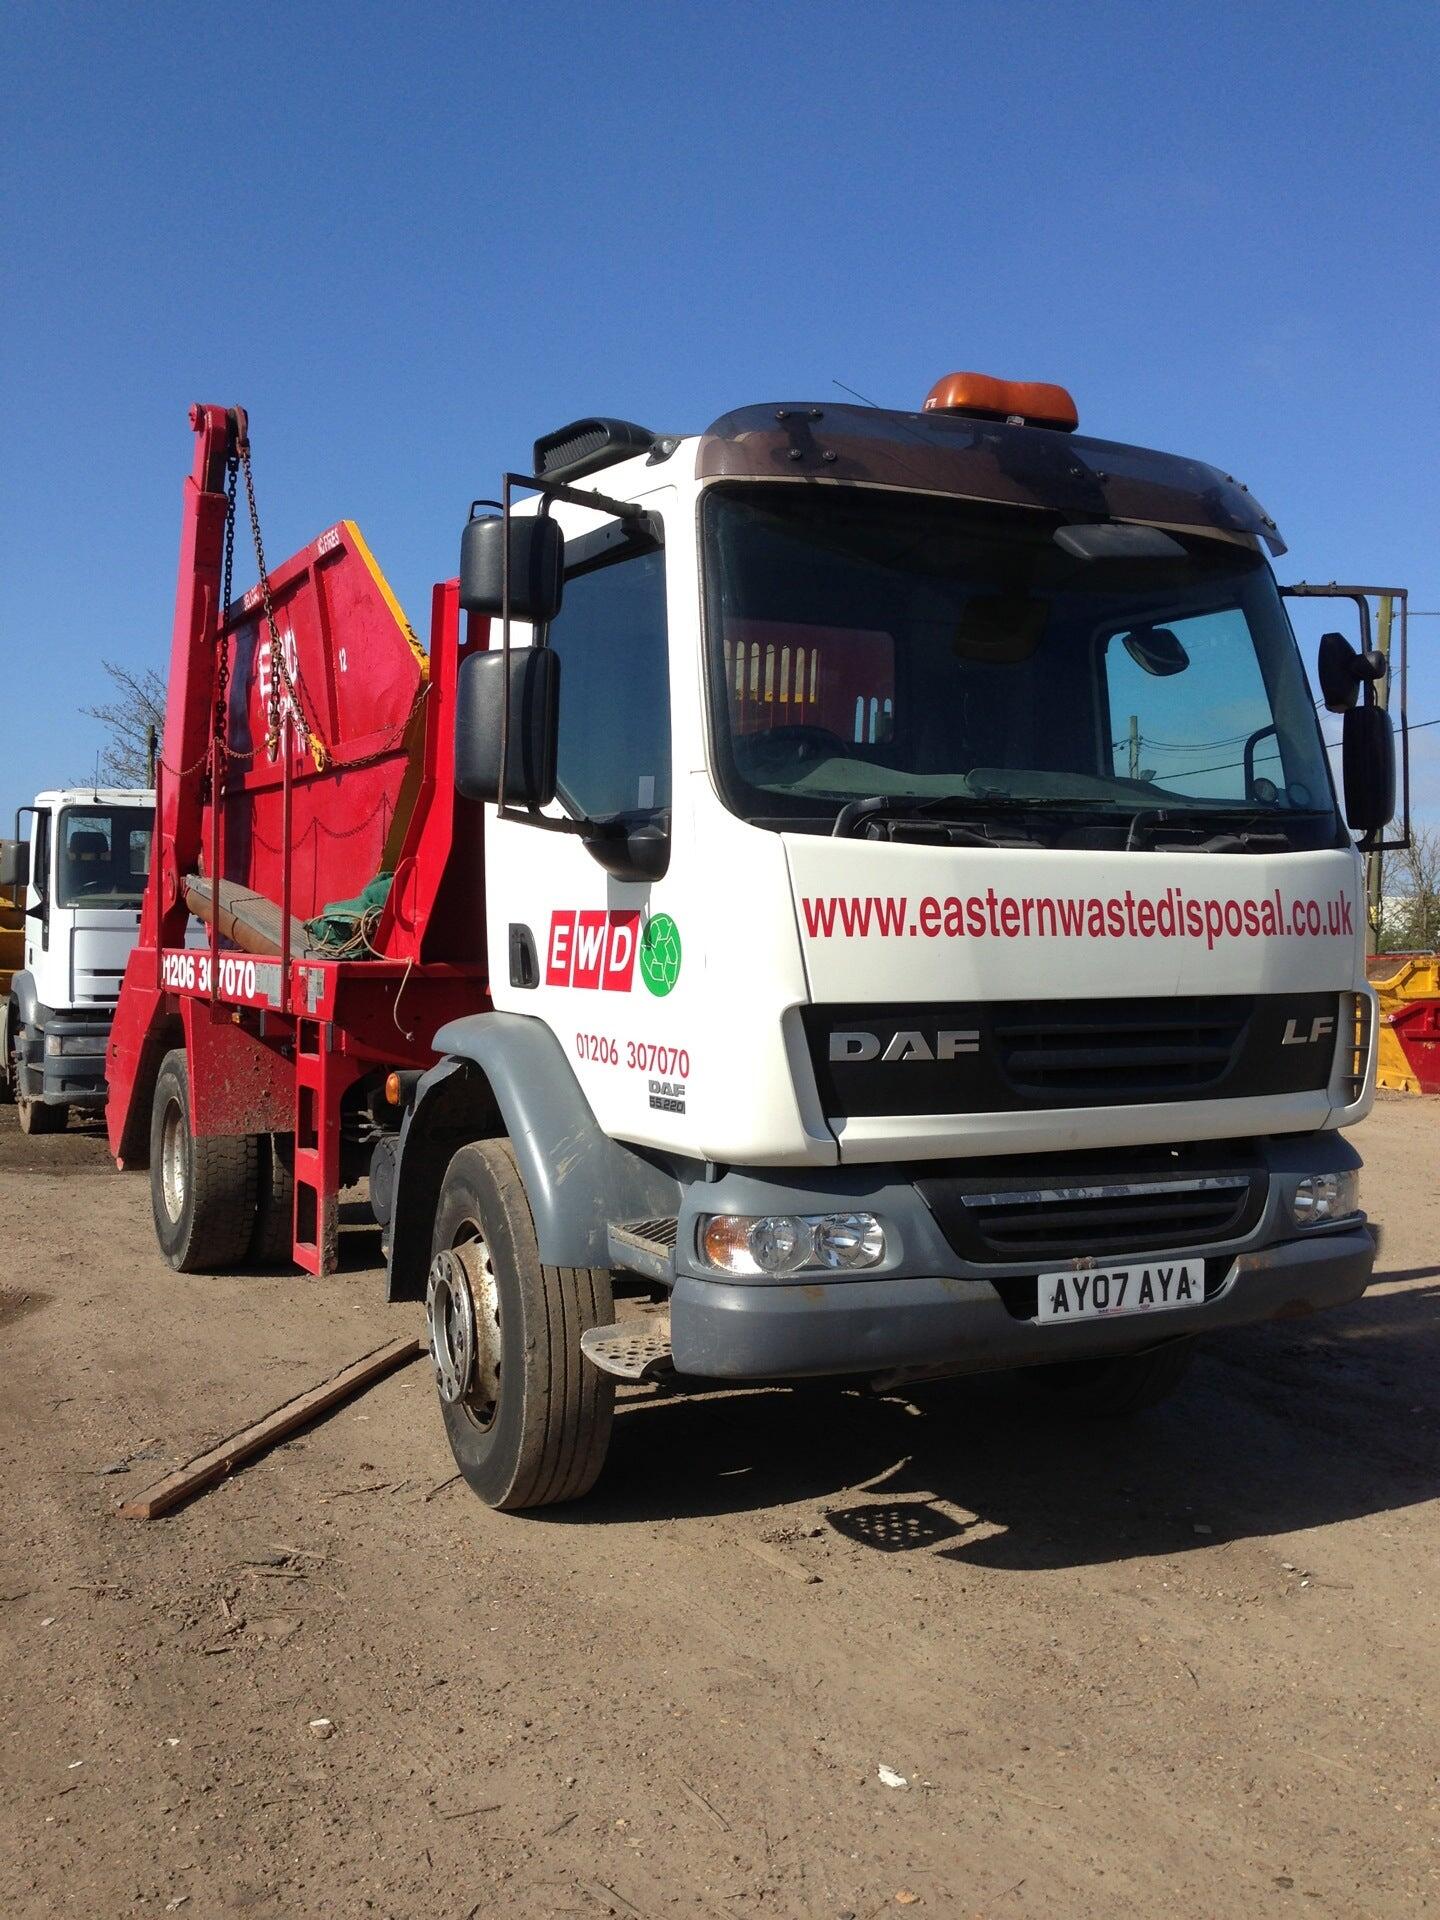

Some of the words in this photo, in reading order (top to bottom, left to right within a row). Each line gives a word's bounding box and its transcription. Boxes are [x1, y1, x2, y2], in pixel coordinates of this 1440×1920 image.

[802, 887, 1354, 950] www.easternwastedisposal.co.uk
[550, 924, 633, 973] EWD
[162, 954, 195, 990] 1206
[829, 1030, 980, 1062] DAF
[1281, 1016, 1335, 1045] LF
[576, 1032, 618, 1066] 01206
[627, 1041, 690, 1079] 307070
[648, 1079, 686, 1098] DAF
[1053, 1272, 1129, 1314] AY07
[1138, 1266, 1192, 1305] AYA
